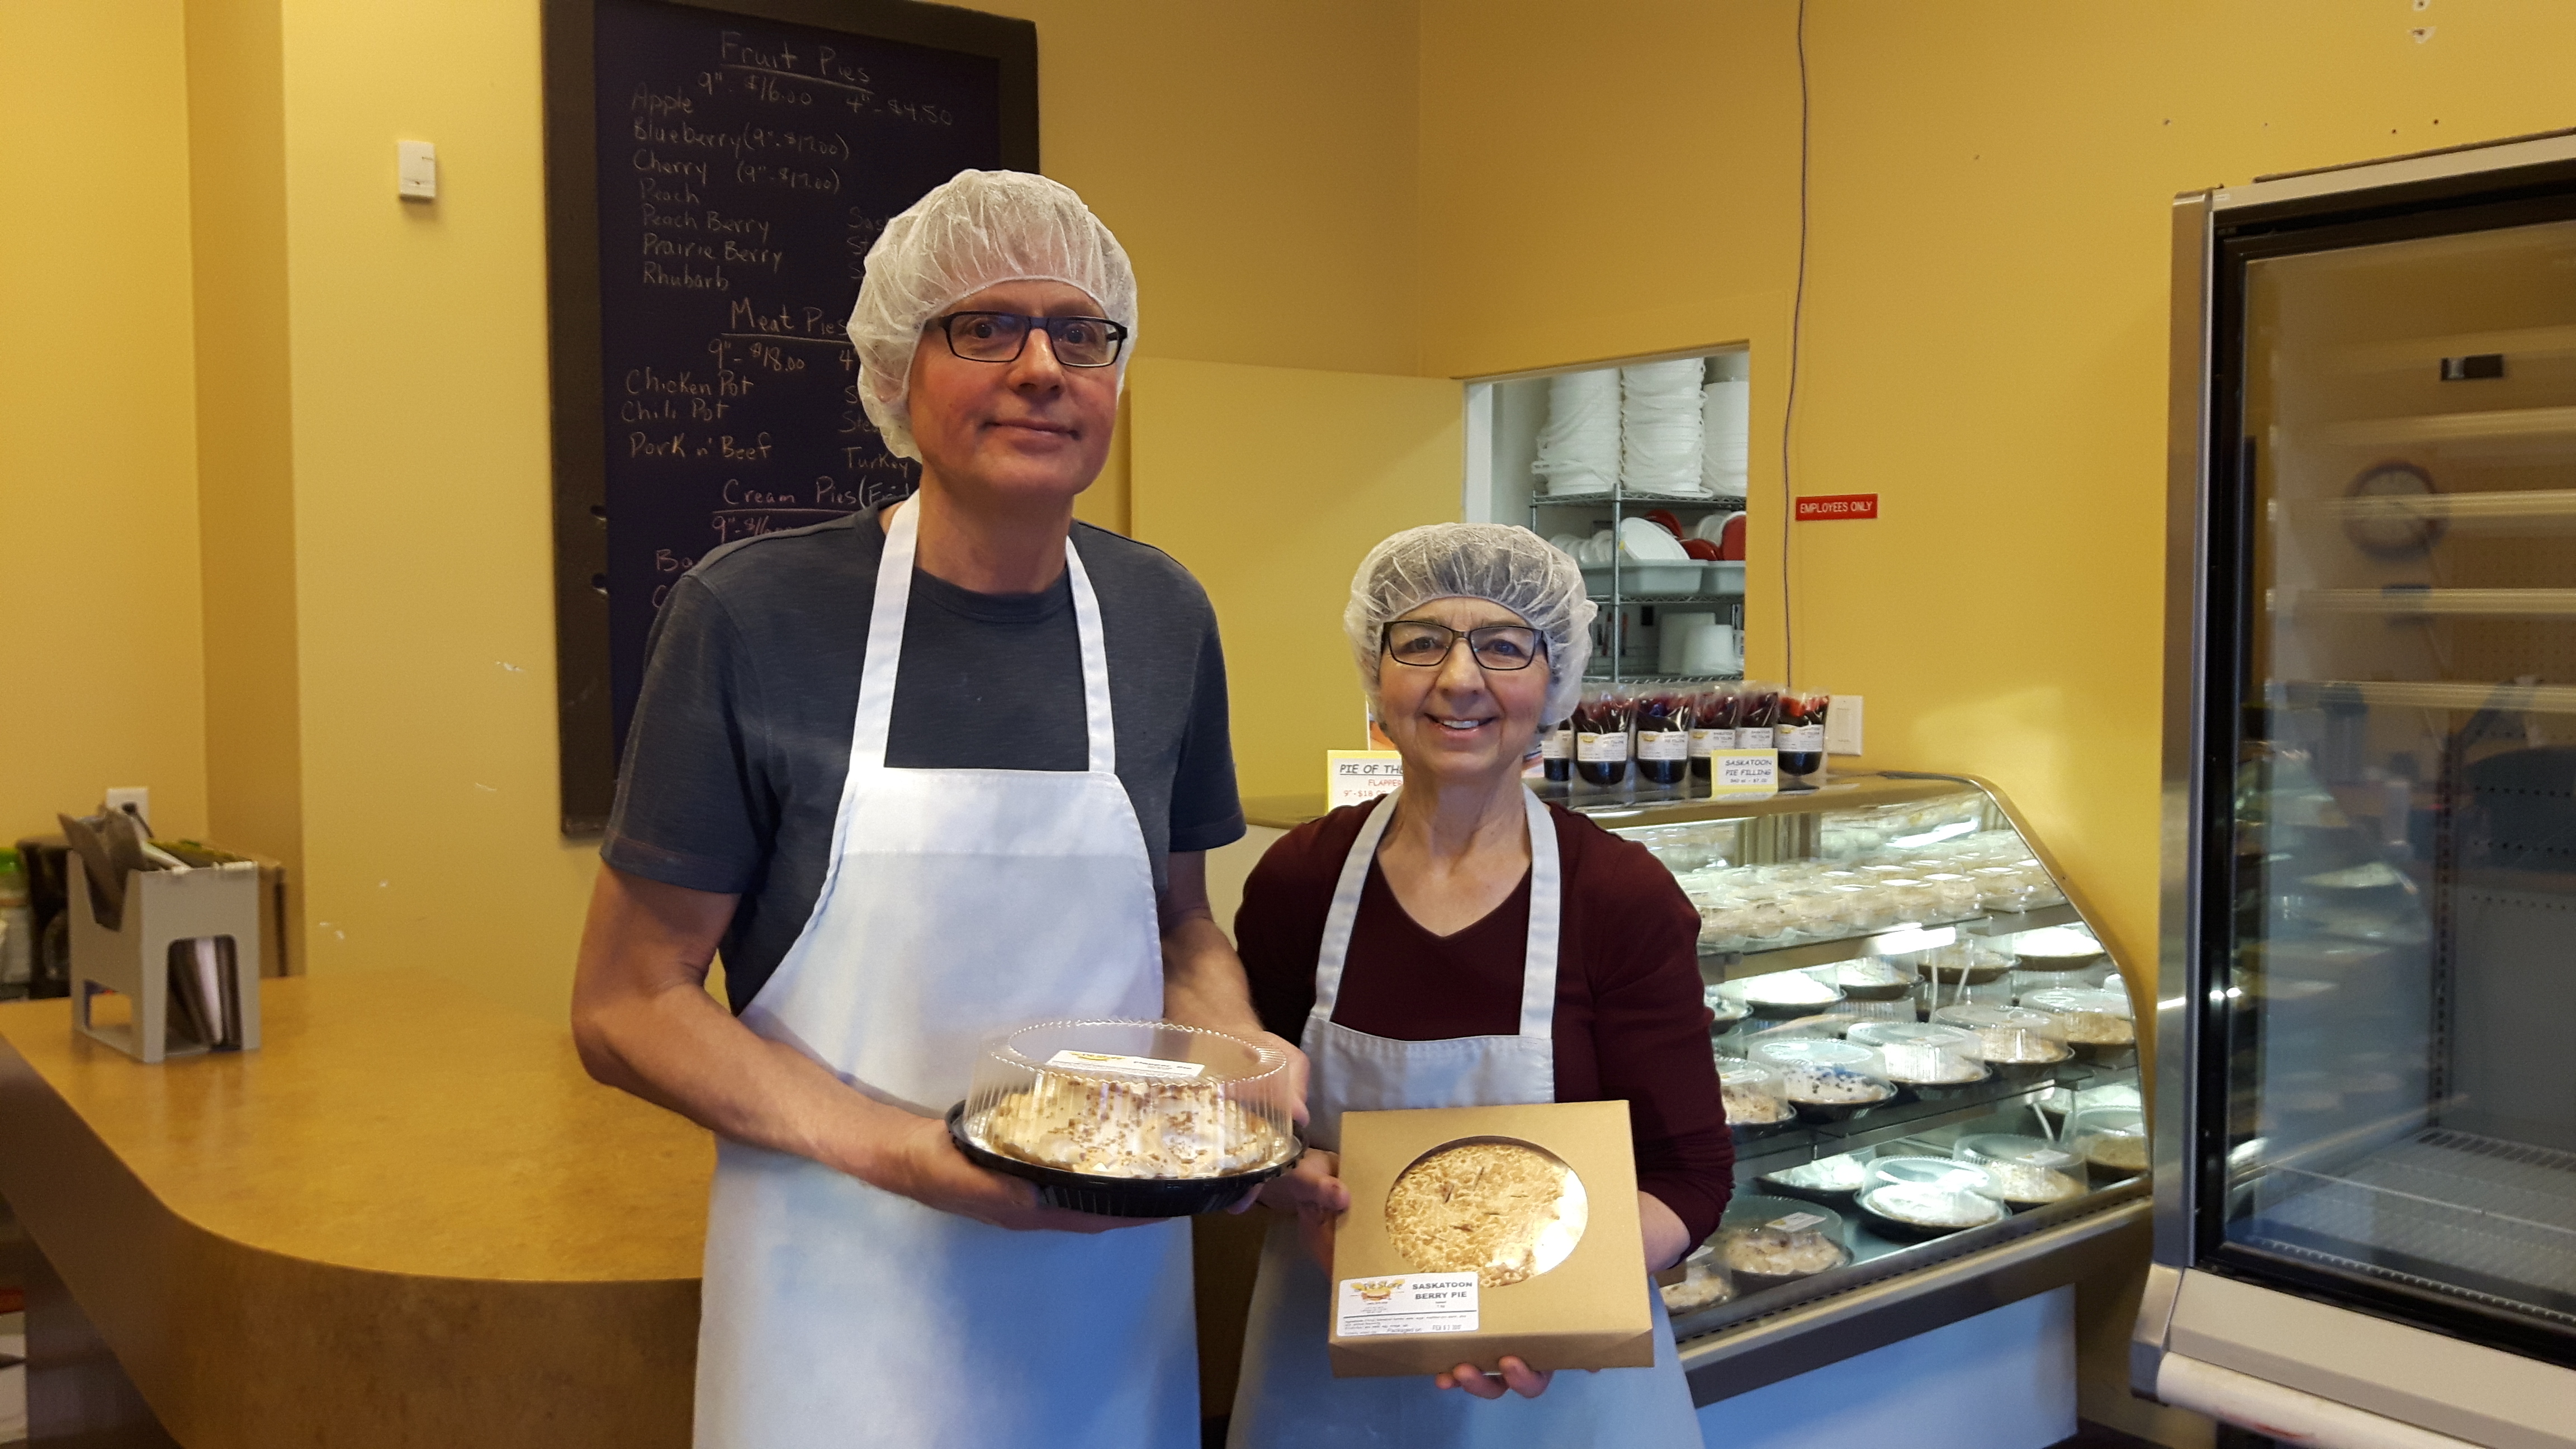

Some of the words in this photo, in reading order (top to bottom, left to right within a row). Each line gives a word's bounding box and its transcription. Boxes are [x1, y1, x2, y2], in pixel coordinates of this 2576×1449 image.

[721, 31, 797, 69] Fruit
[818, 45, 870, 83] Pies
[632, 82, 694, 116] Apple
[633, 149, 707, 187] Cherry
[640, 177, 700, 204] Peach
[642, 203, 698, 230] Peach
[707, 211, 770, 244] Berry
[643, 233, 717, 260] Prairie
[724, 240, 783, 274] Berry
[643, 261, 729, 291] Rhubarb
[731, 297, 794, 332] Meat
[803, 307, 849, 335] Pies
[749, 342, 806, 372] $18.00
[626, 367, 712, 396] Chicken
[718, 369, 754, 396] Pot
[621, 399, 676, 423] Chili
[692, 397, 730, 422] Pot
[630, 432, 685, 458] Pork
[722, 432, 772, 460] Beef
[841, 446, 909, 479] Turkey
[723, 479, 795, 505] Cream
[816, 475, 856, 504] Pies
[1800, 502, 1848, 513] EMPLOYEES
[1850, 501, 1873, 512] ONLY
[1340, 764, 1360, 774] PIE
[1363, 764, 1379, 774] OF
